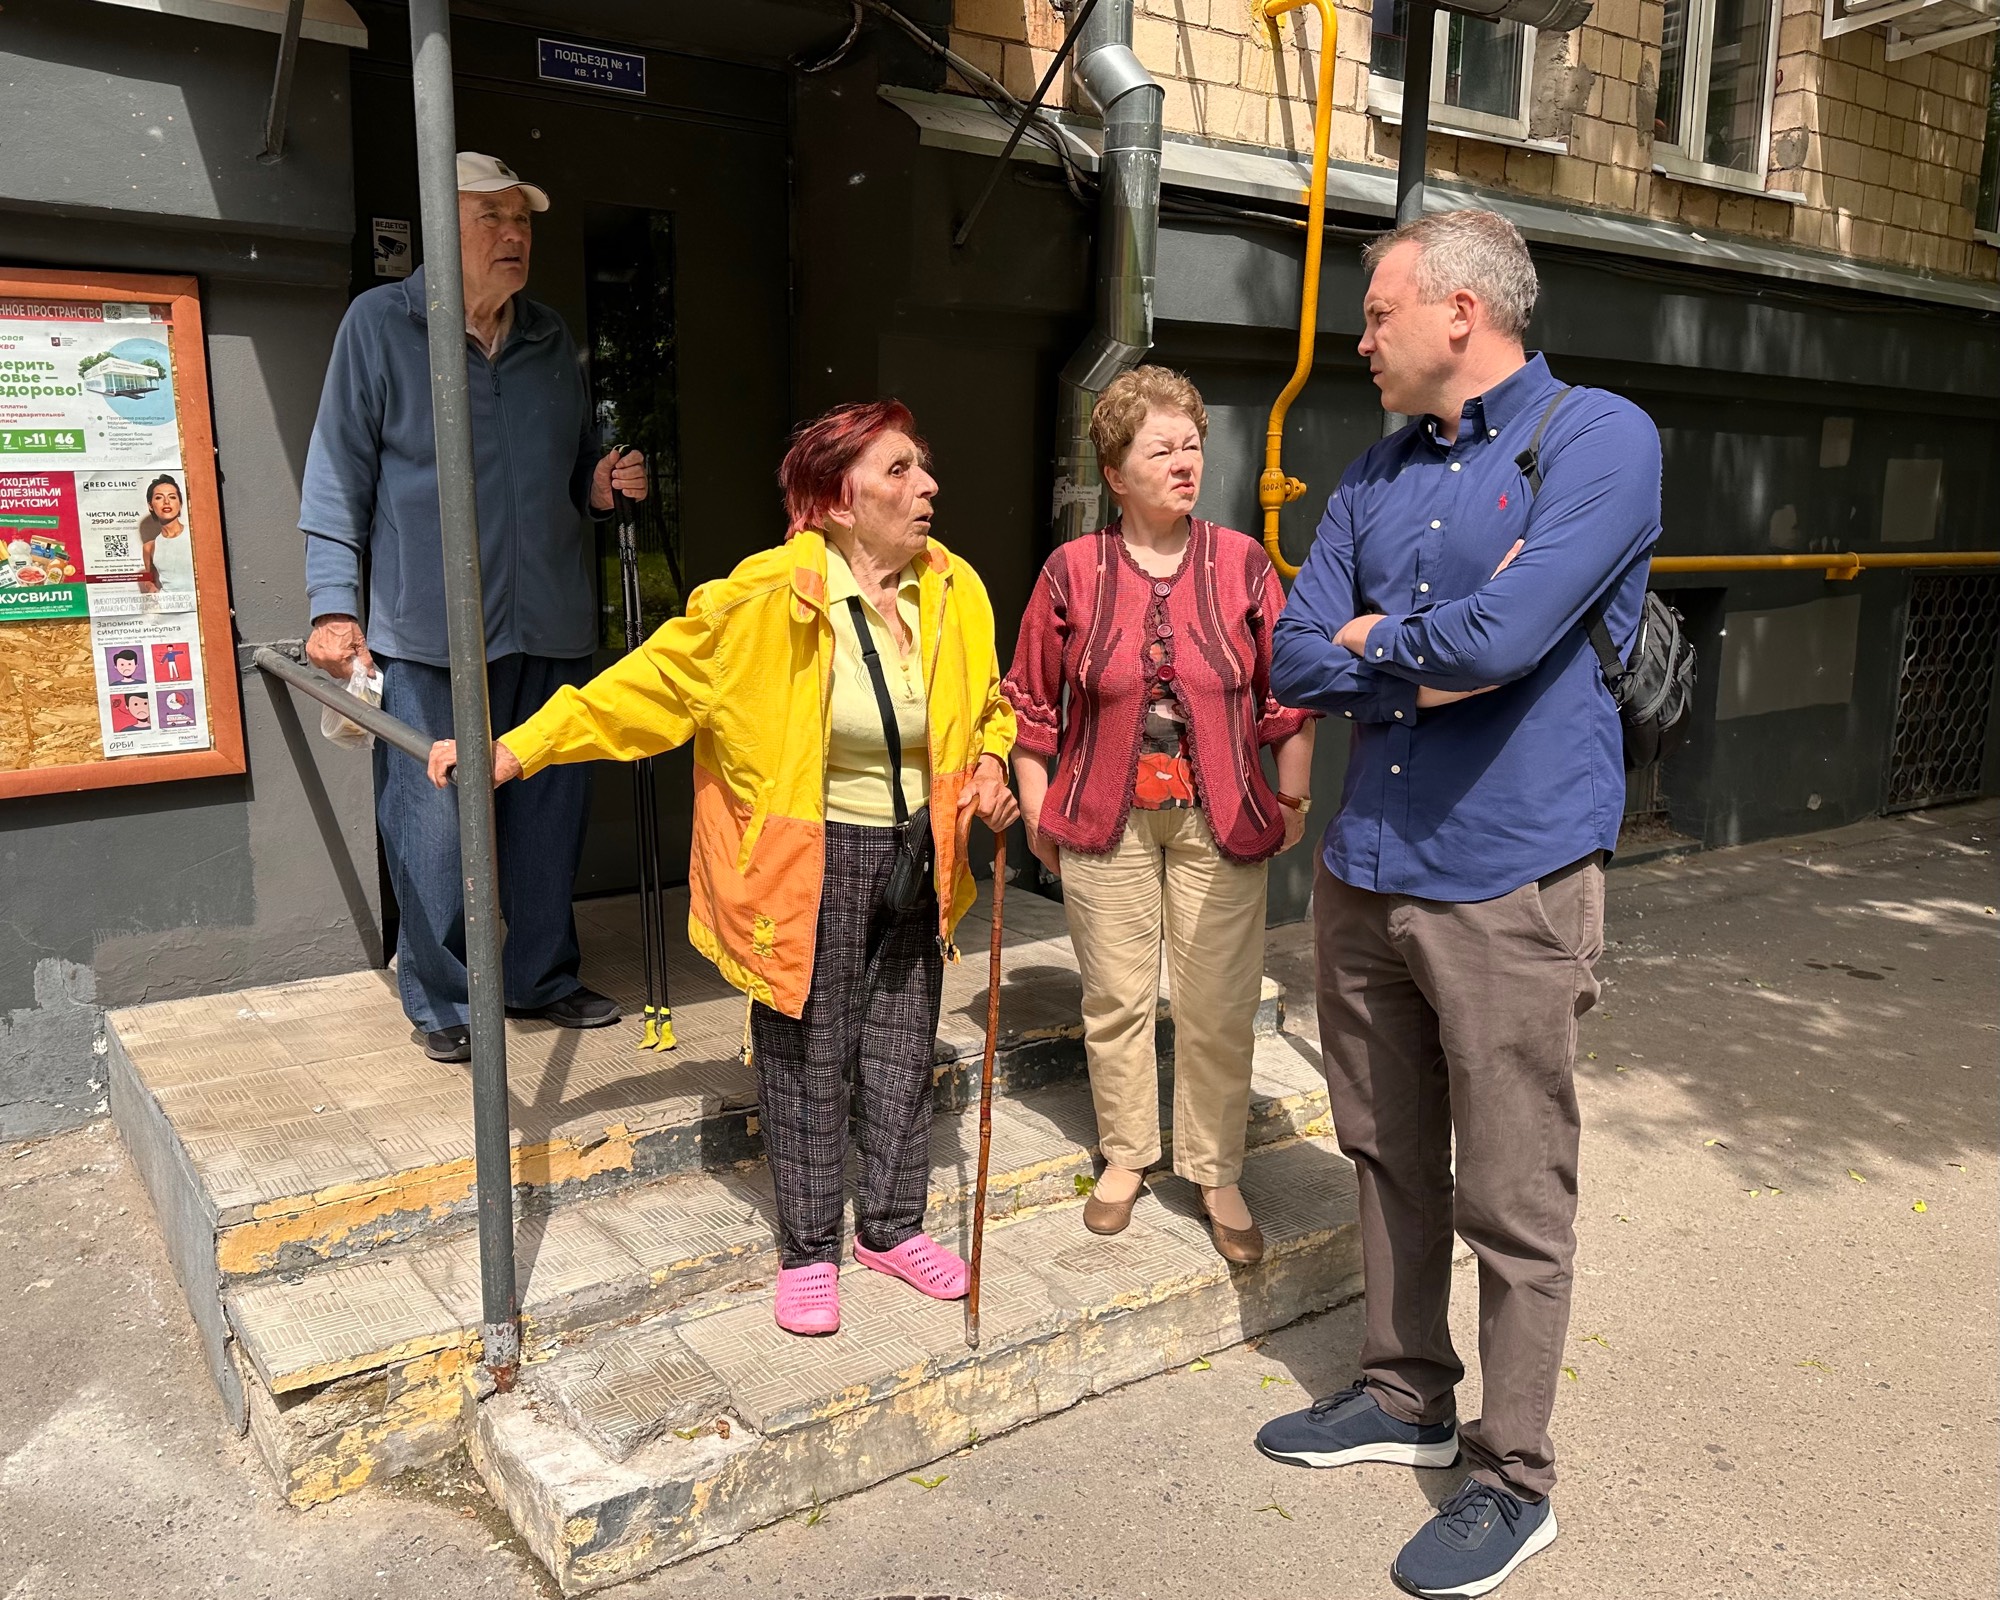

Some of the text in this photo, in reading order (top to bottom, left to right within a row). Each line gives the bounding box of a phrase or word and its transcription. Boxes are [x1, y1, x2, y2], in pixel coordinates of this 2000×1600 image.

[555, 49, 630, 71] ПОДЪЕЗД № 1
[592, 69, 597, 79] 1
[606, 71, 613, 81] 9
[375, 221, 408, 230] ВЕДЕТСЯ
[27, 305, 102, 320] ПРОСТРАНСТВО
[0, 374, 41, 383] овье
[0, 383, 83, 399] здорово!
[2, 433, 12, 445] 7
[24, 433, 46, 445] >11
[54, 433, 75, 445] 46
[0, 488, 61, 497] ОЛЕЗНЫМИ
[0, 590, 73, 604] КУСВИЛЛ
[97, 620, 143, 628] Запомните
[97, 625, 181, 636] симптомы инсульта
[109, 741, 134, 750] ОРБИ
